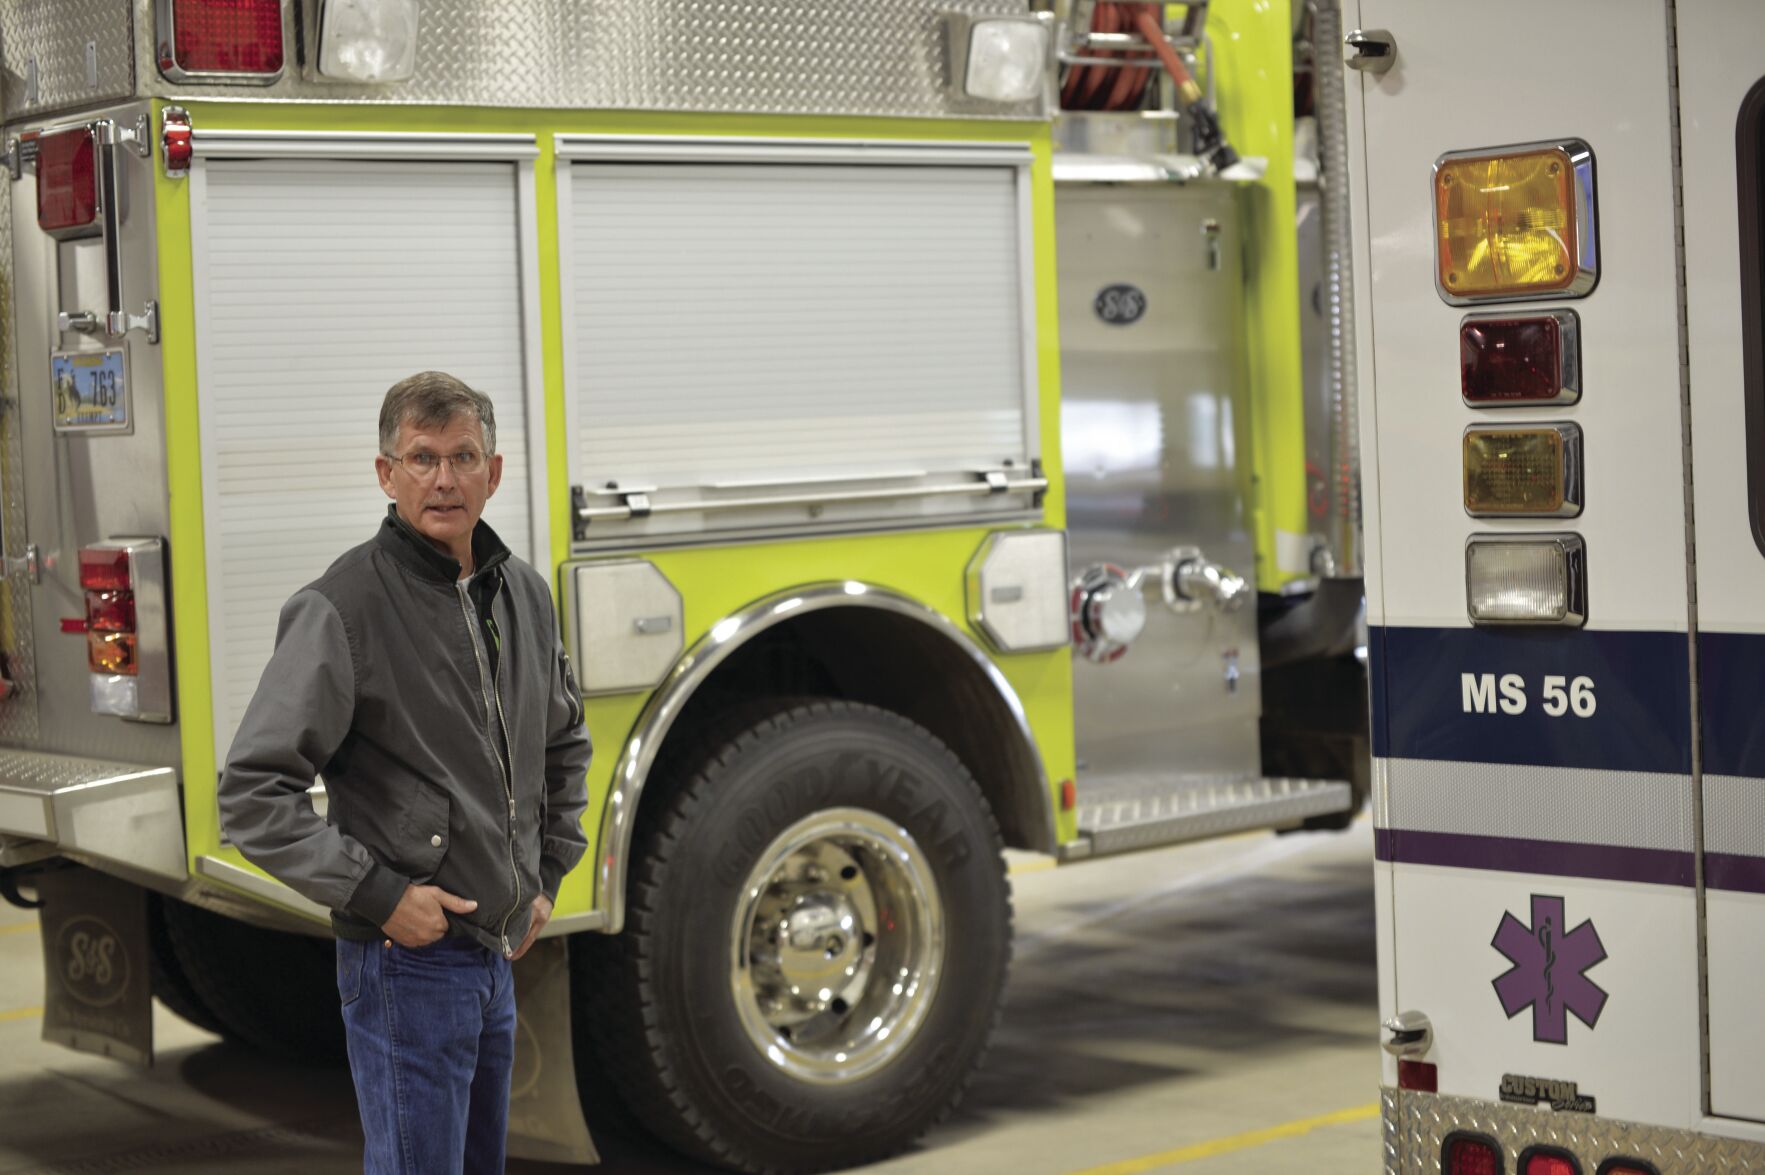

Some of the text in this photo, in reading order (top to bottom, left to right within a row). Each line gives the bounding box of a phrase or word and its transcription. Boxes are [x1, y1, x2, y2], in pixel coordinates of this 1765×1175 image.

[90, 370, 116, 406] 763
[1461, 672, 1597, 718] MS 56
[1501, 1074, 1578, 1101] CUSTOM
